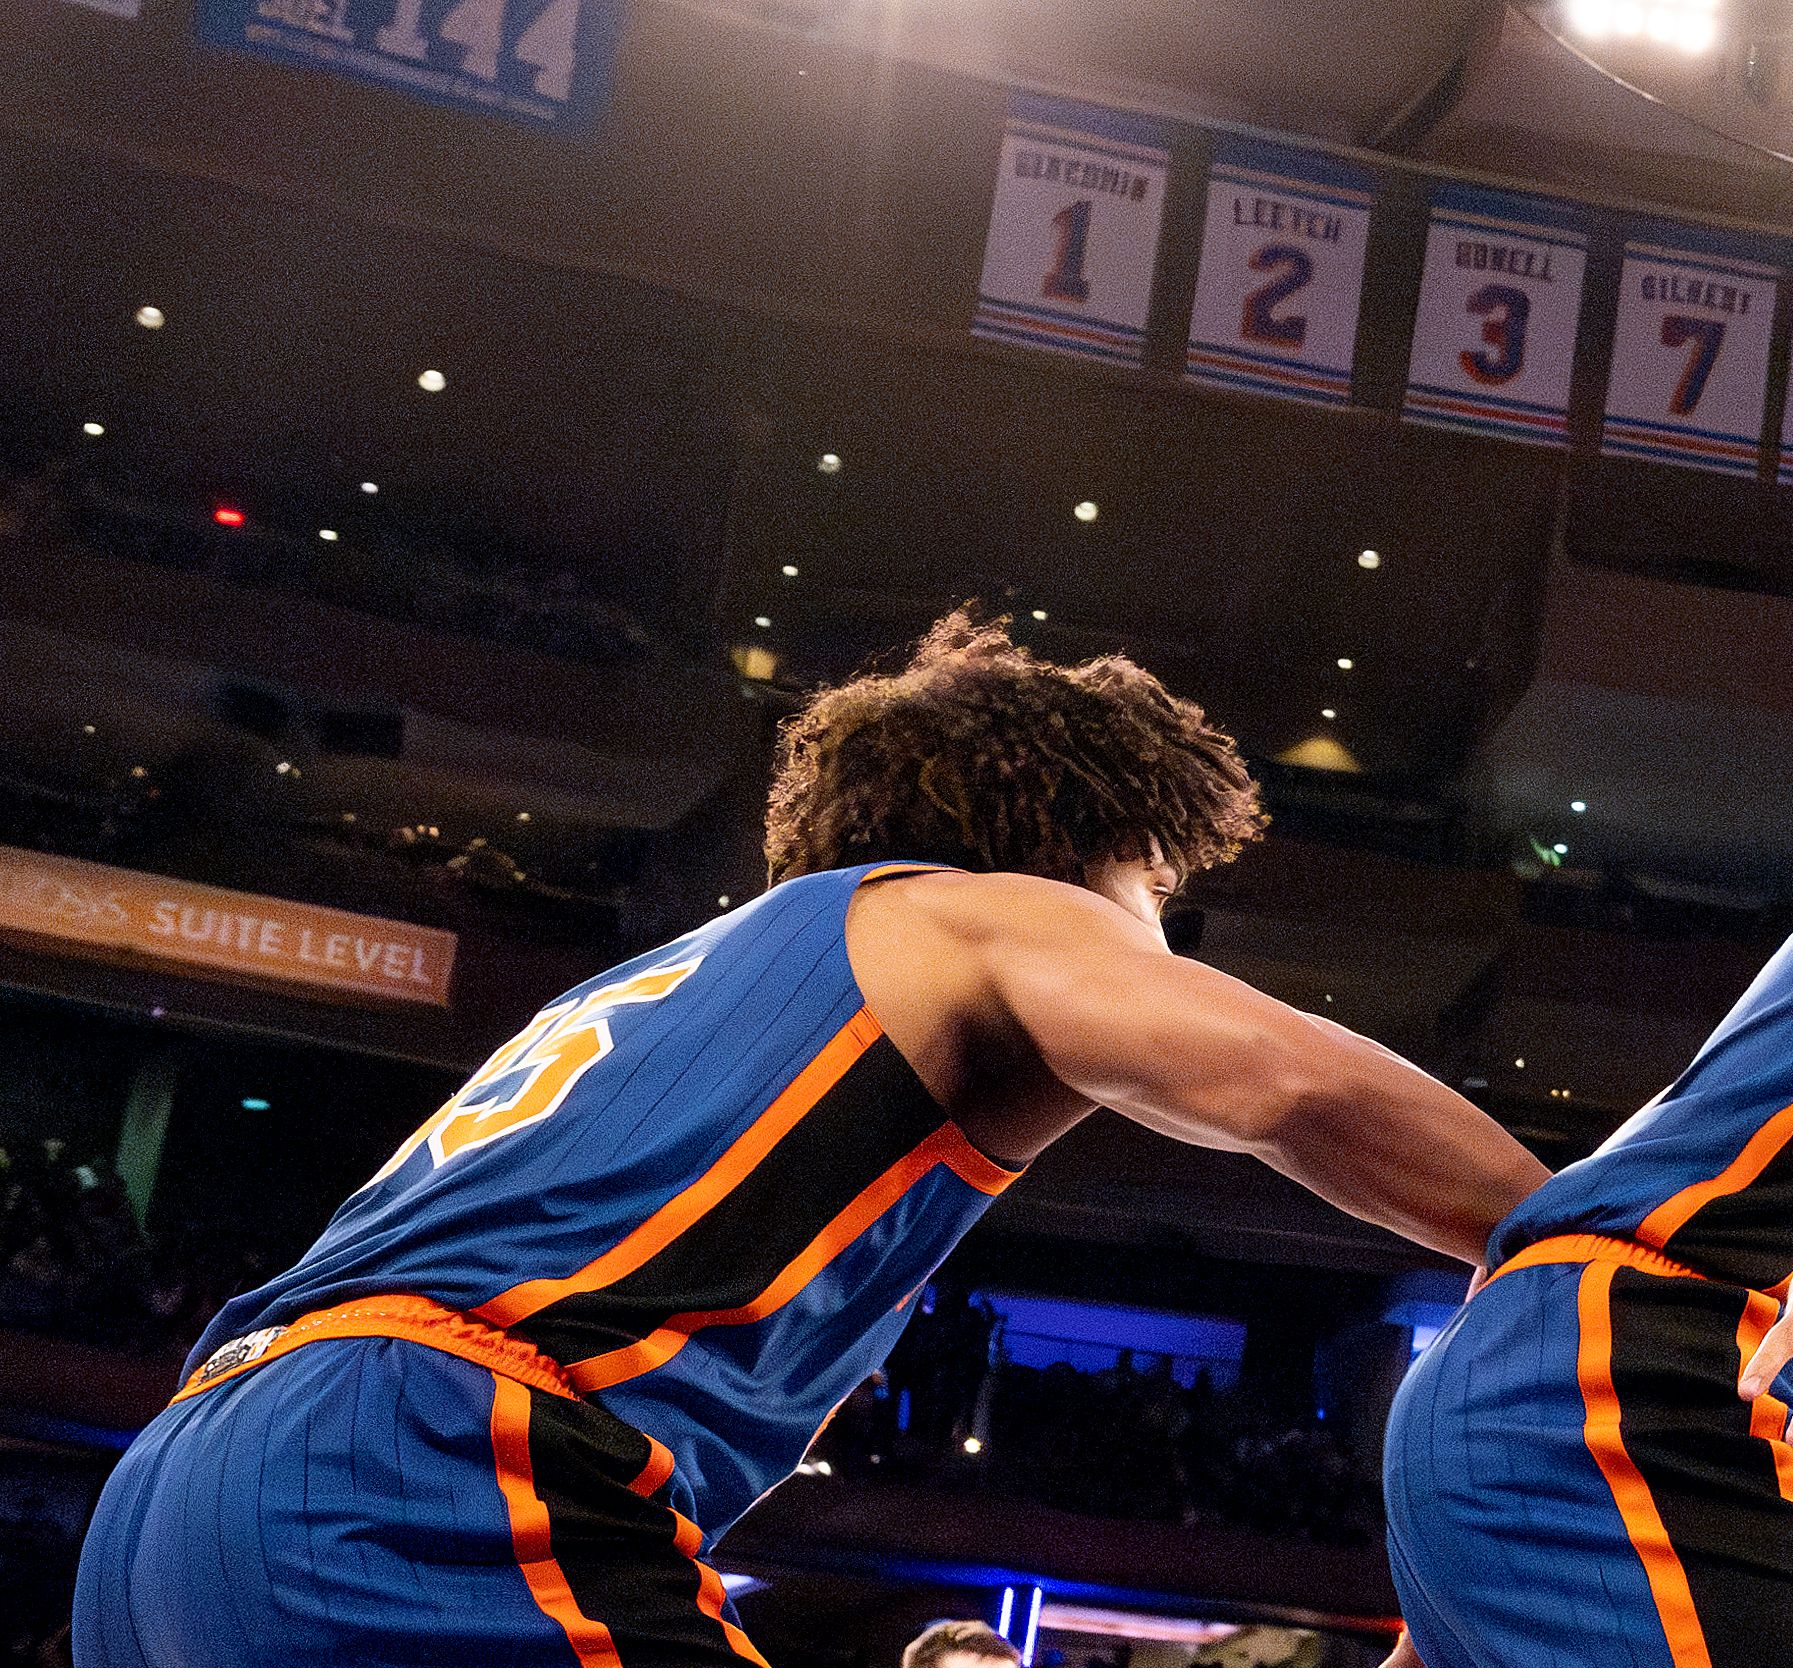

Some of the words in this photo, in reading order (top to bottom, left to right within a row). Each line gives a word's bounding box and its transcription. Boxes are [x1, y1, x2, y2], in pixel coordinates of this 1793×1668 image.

[1043, 201, 1093, 302] 1
[1233, 197, 1341, 243] LEETCH
[1241, 243, 1313, 348] 2
[1459, 283, 1531, 386] 3
[1661, 315, 1725, 416] 7
[148, 898, 286, 955] SUITE
[299, 927, 432, 984] LEVEL
